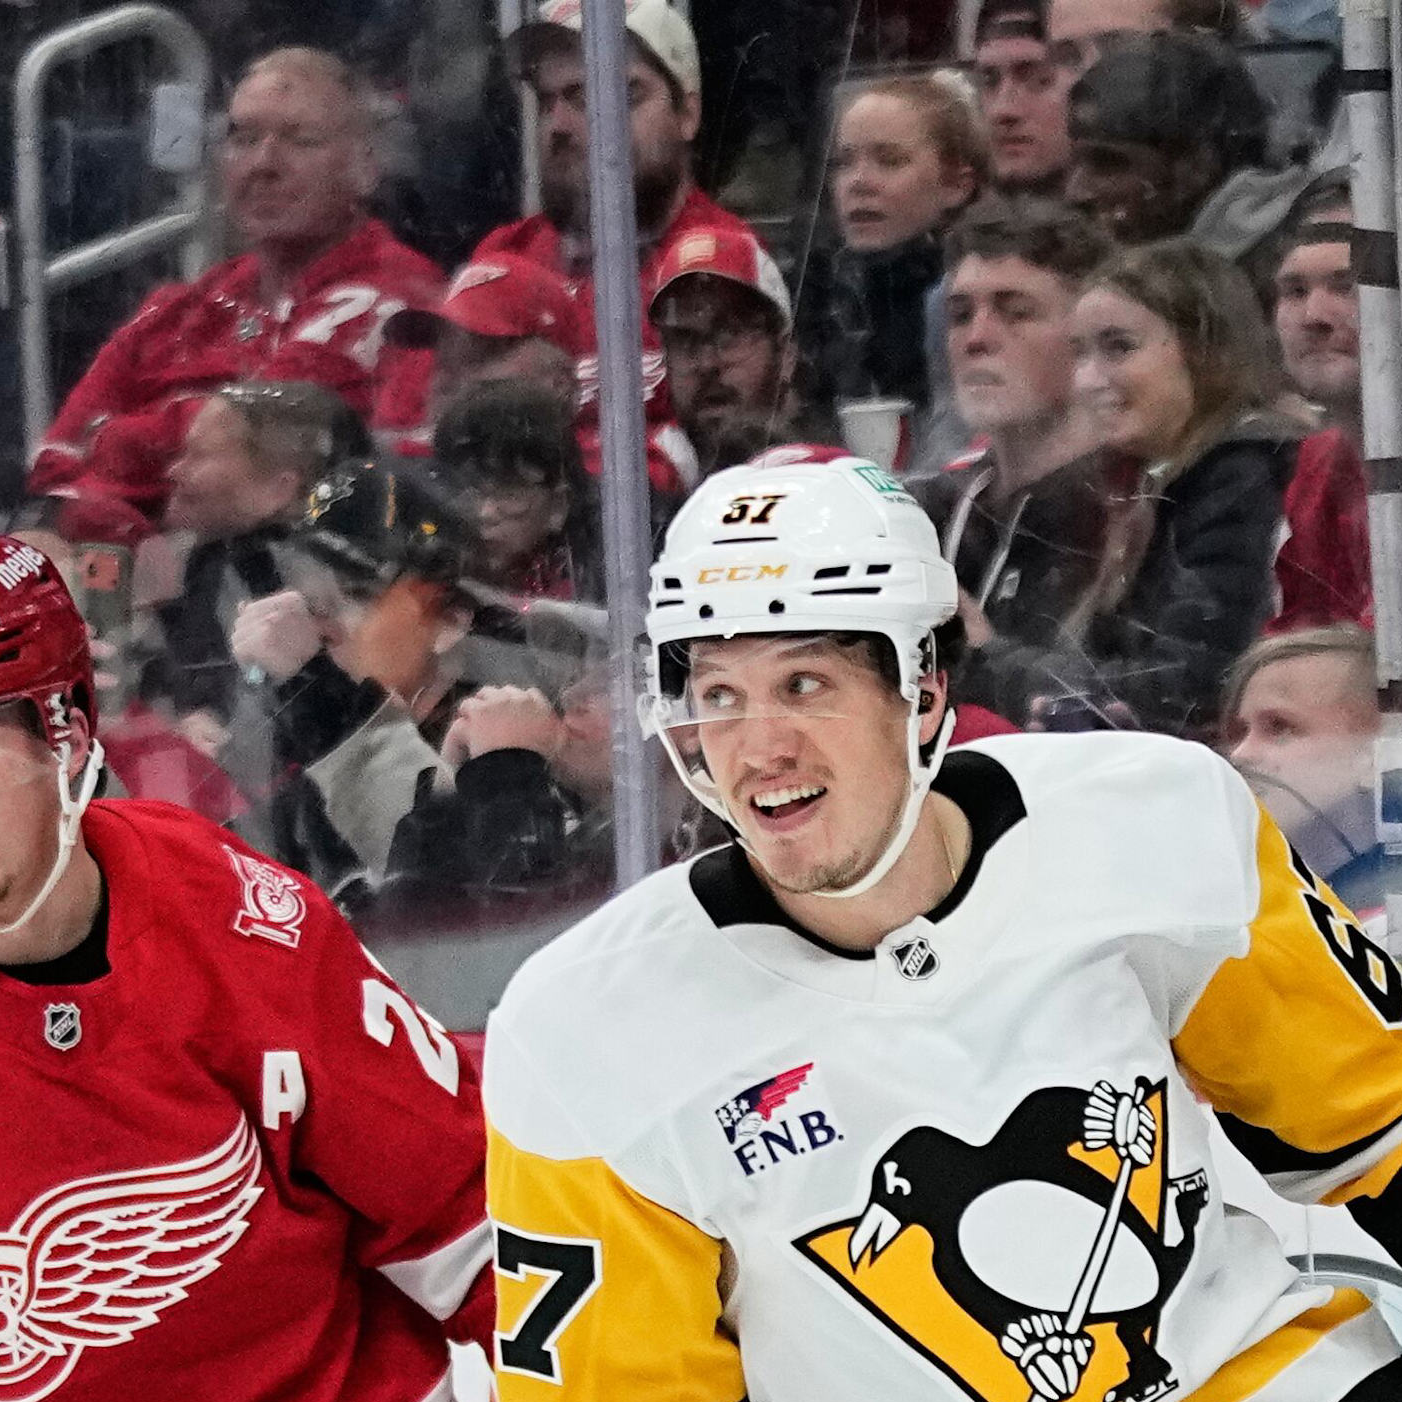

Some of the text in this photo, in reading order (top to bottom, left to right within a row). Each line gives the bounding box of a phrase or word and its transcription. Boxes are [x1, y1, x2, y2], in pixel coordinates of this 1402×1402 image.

[697, 564, 789, 585] CCM
[361, 943, 460, 1098] 2
[263, 1051, 307, 1132] A
[734, 1110, 845, 1177] F.N.B.
